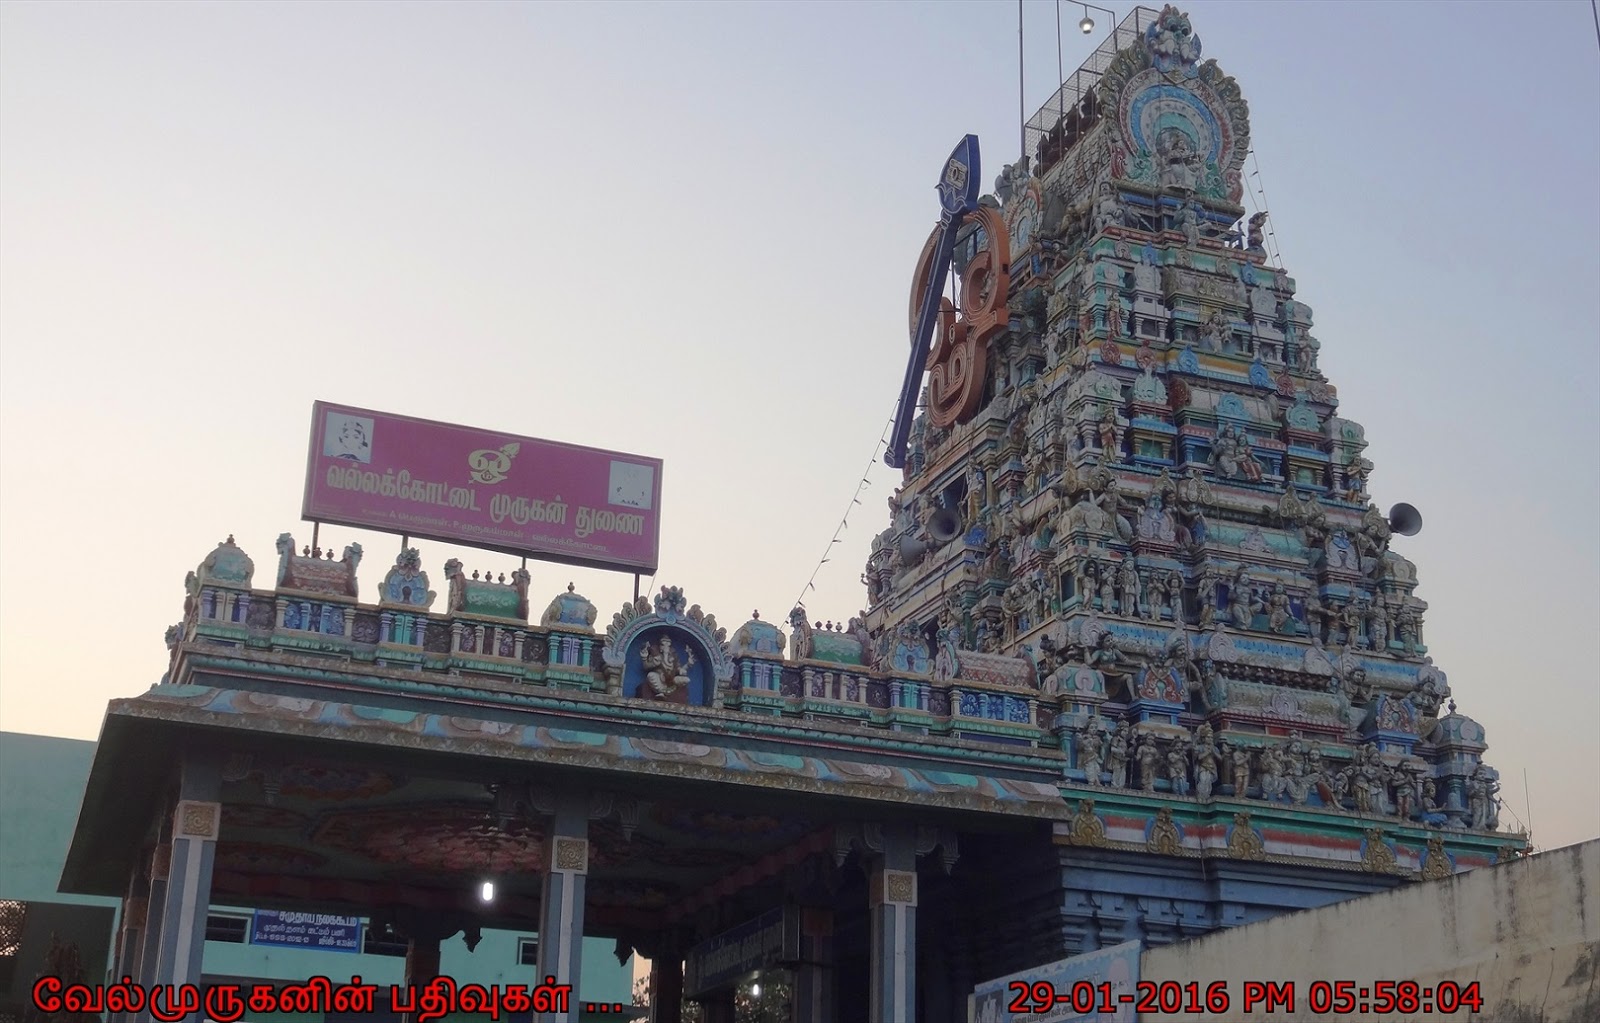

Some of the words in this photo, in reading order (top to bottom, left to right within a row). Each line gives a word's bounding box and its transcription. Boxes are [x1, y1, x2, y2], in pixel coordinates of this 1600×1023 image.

[327, 463, 481, 512] வல்லக்கோட்டை
[489, 493, 568, 525] முருகன்
[574, 506, 645, 538] துணை
